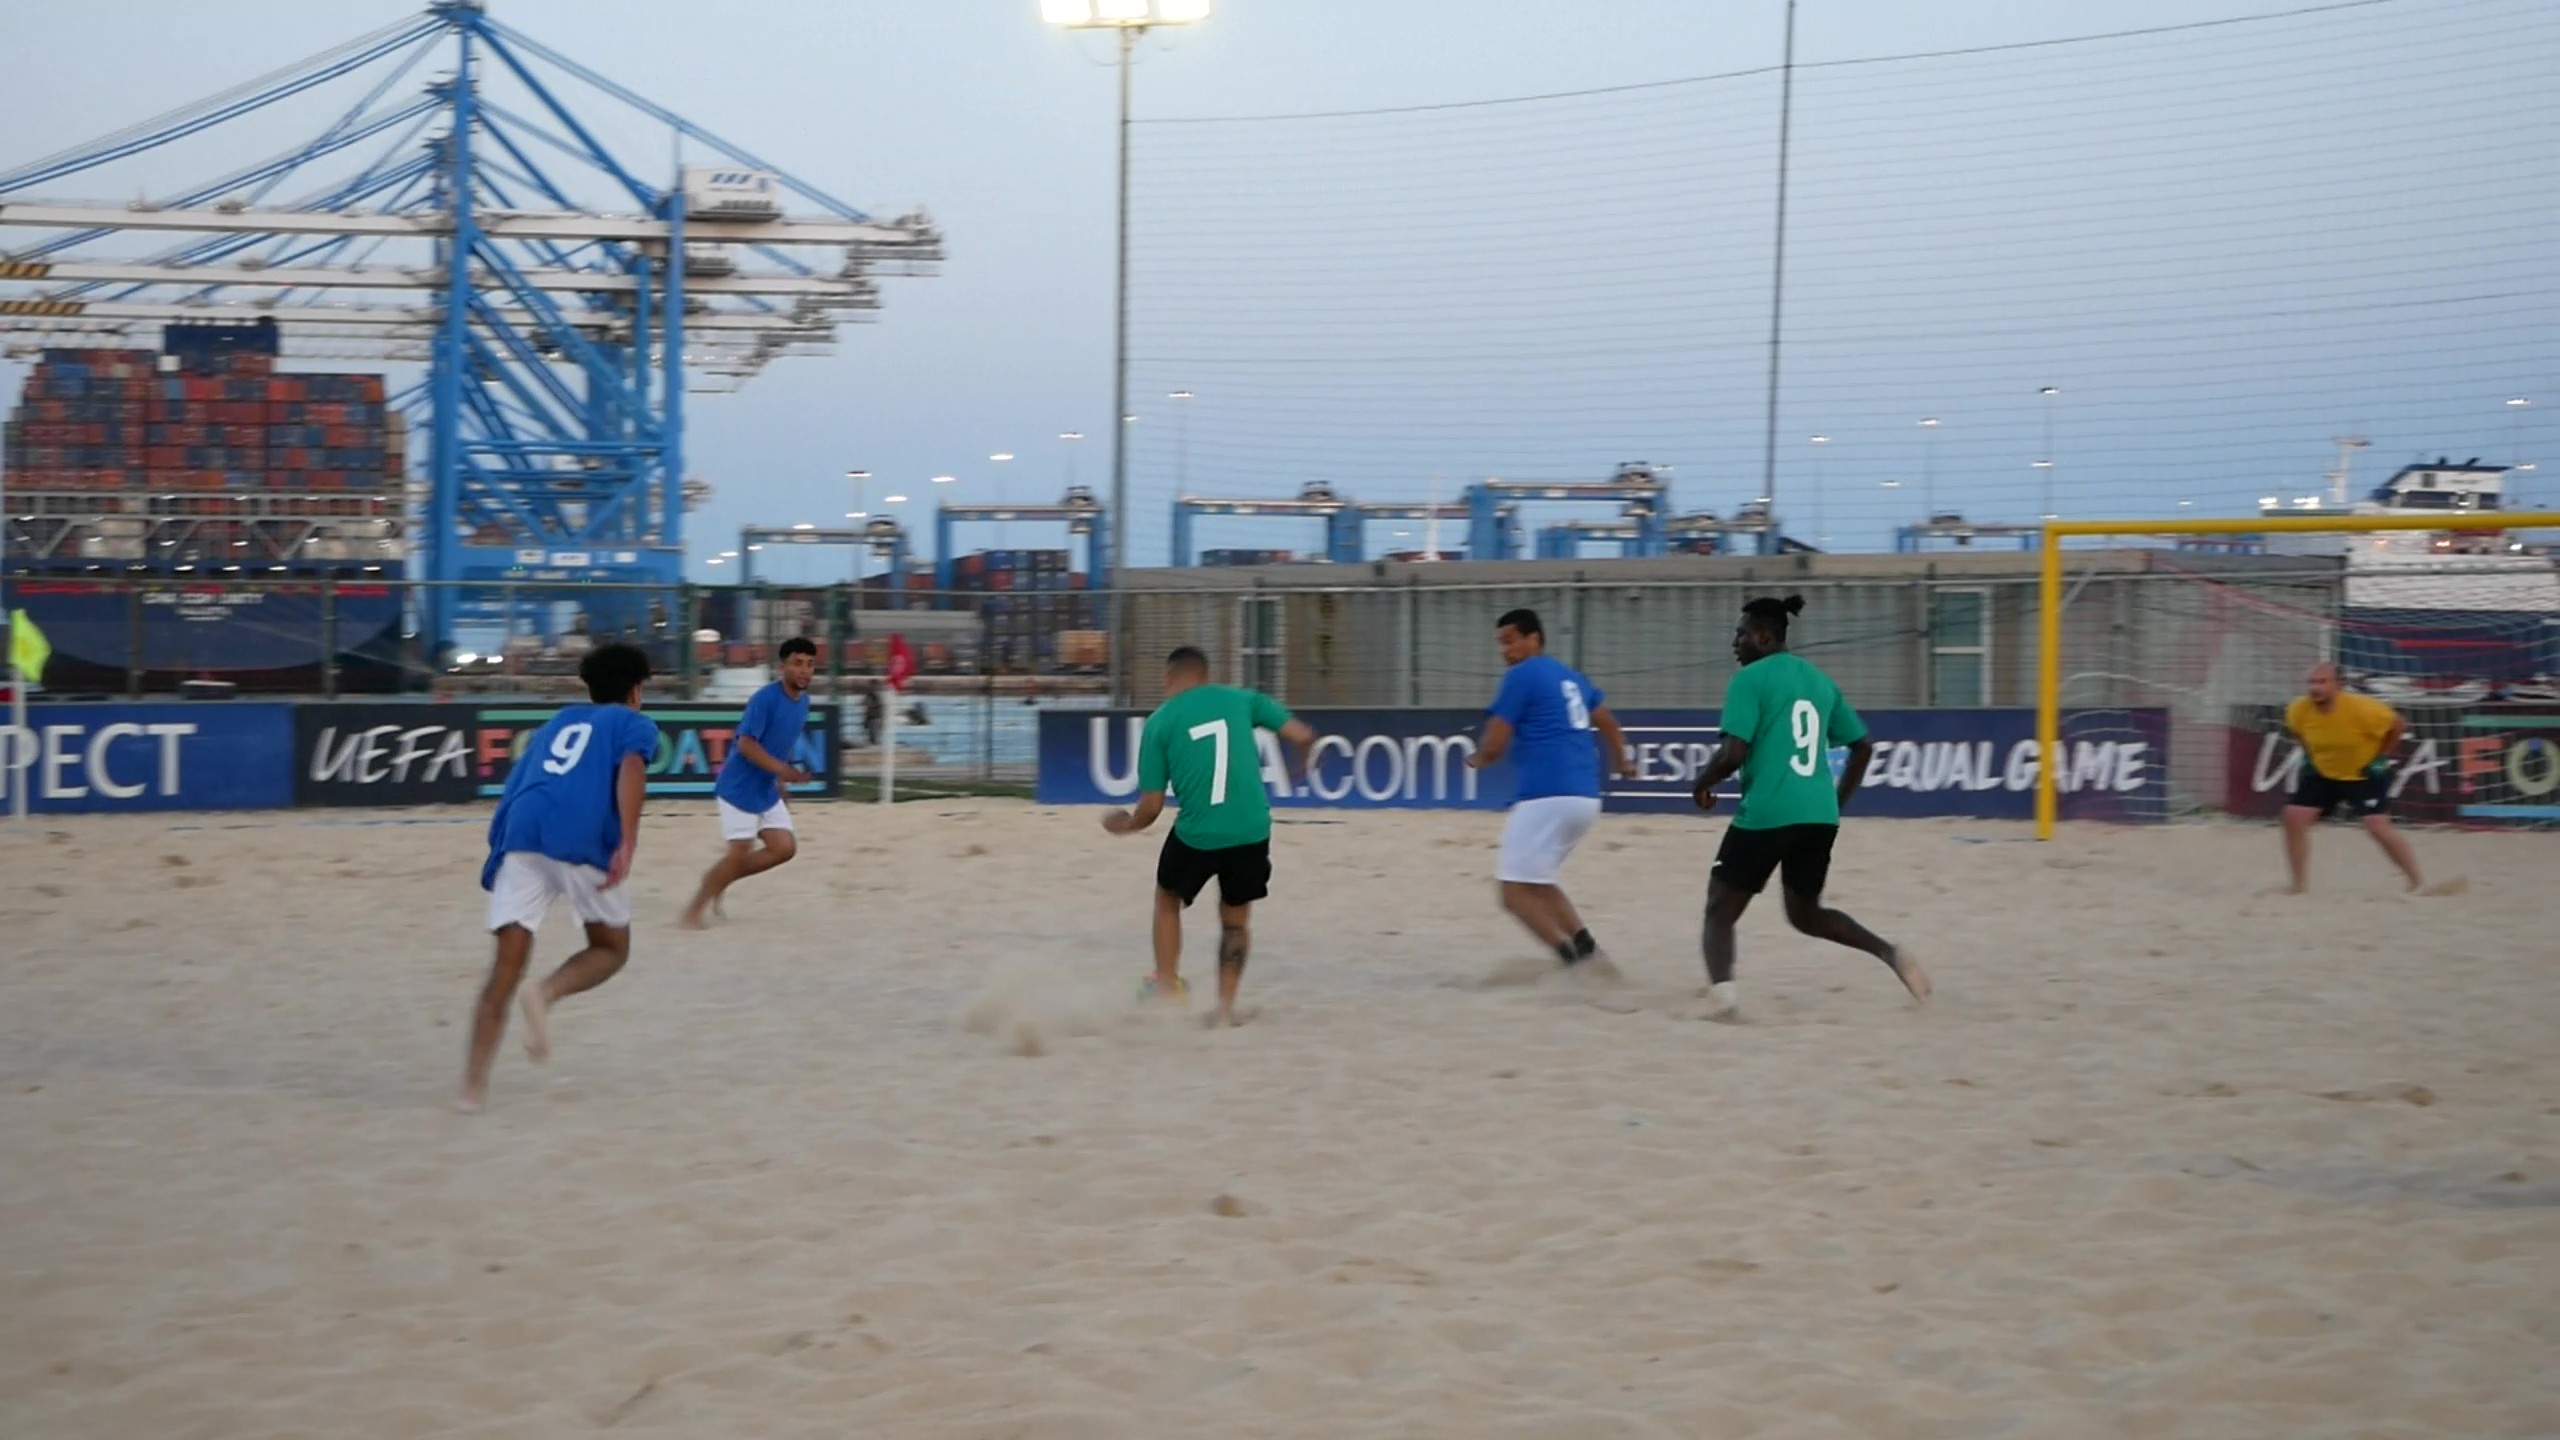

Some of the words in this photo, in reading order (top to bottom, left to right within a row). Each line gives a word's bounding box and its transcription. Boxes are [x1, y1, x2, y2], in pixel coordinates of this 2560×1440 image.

[309, 725, 474, 783] UEFA
[543, 722, 593, 775] 9
[1089, 716, 1477, 802] UA.com
[1188, 718, 1228, 806] 7
[1790, 699, 1820, 776] 9
